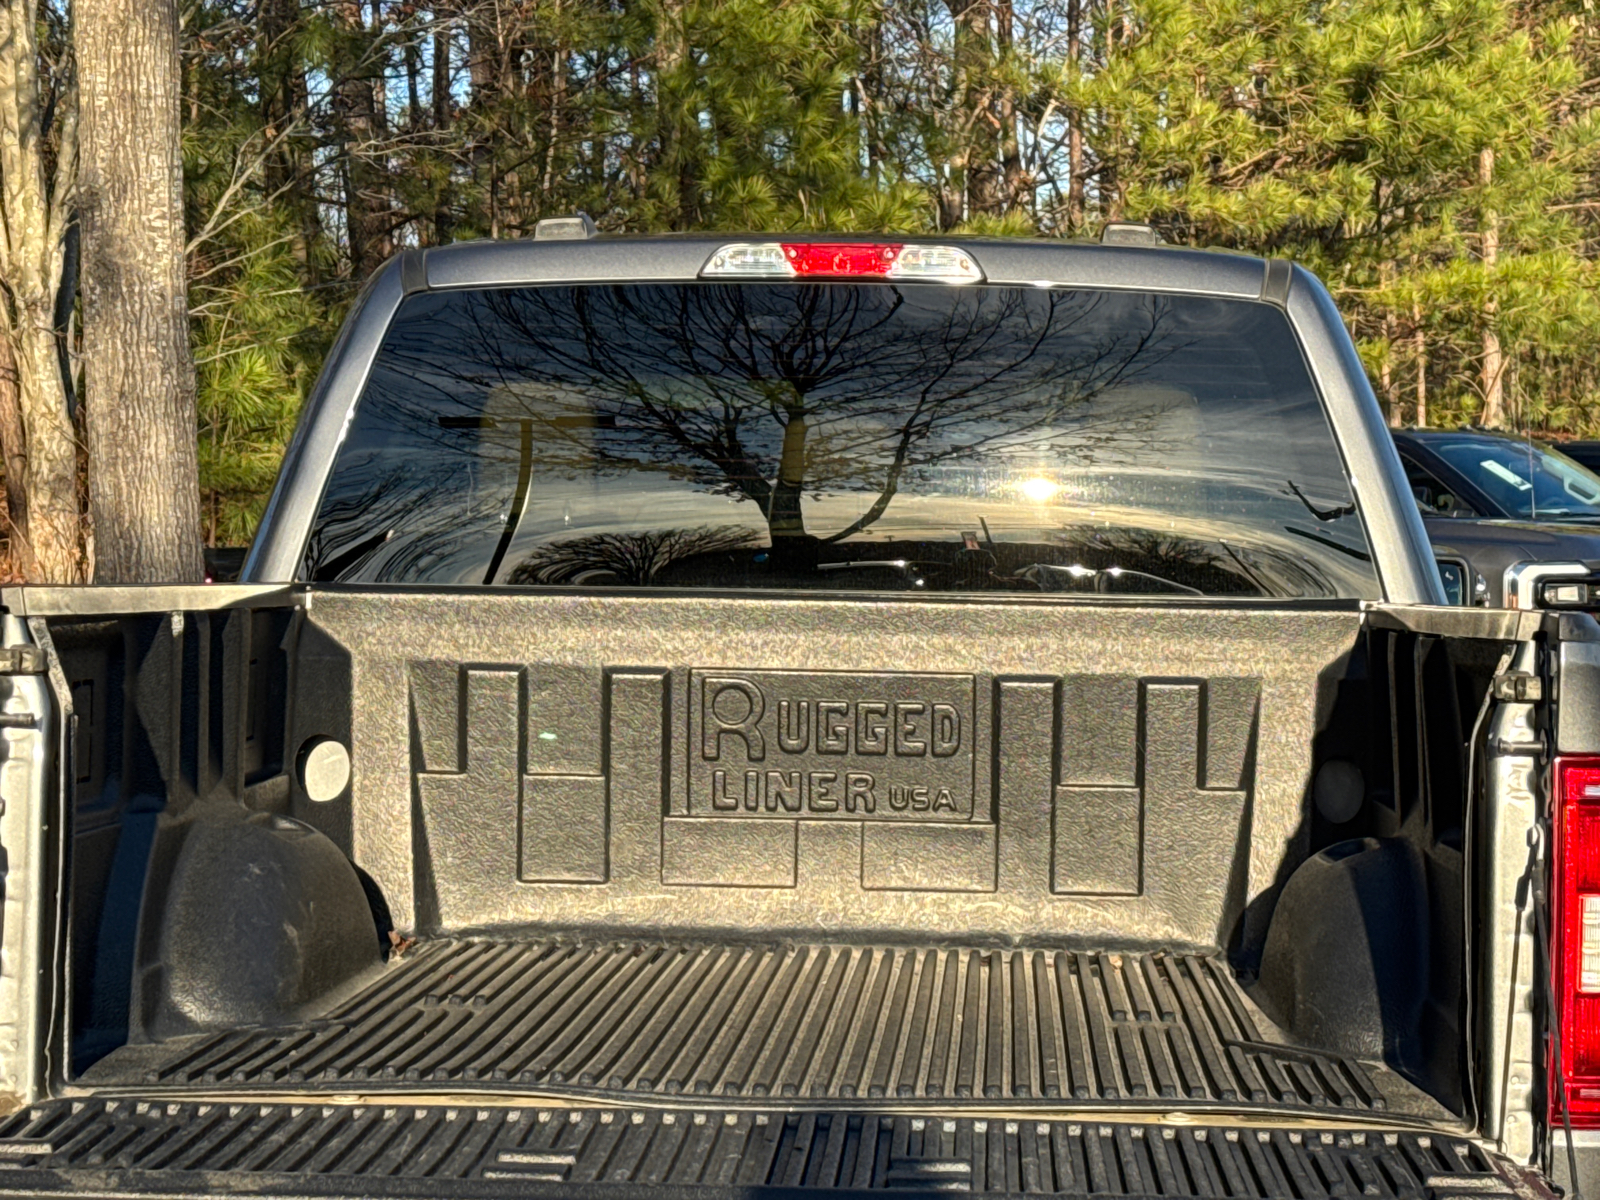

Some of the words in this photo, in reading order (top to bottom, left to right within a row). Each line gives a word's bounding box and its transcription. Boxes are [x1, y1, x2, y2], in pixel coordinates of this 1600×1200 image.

[702, 676, 961, 761] RUGGED
[712, 770, 876, 813] LINER
[888, 785, 957, 812] USA
